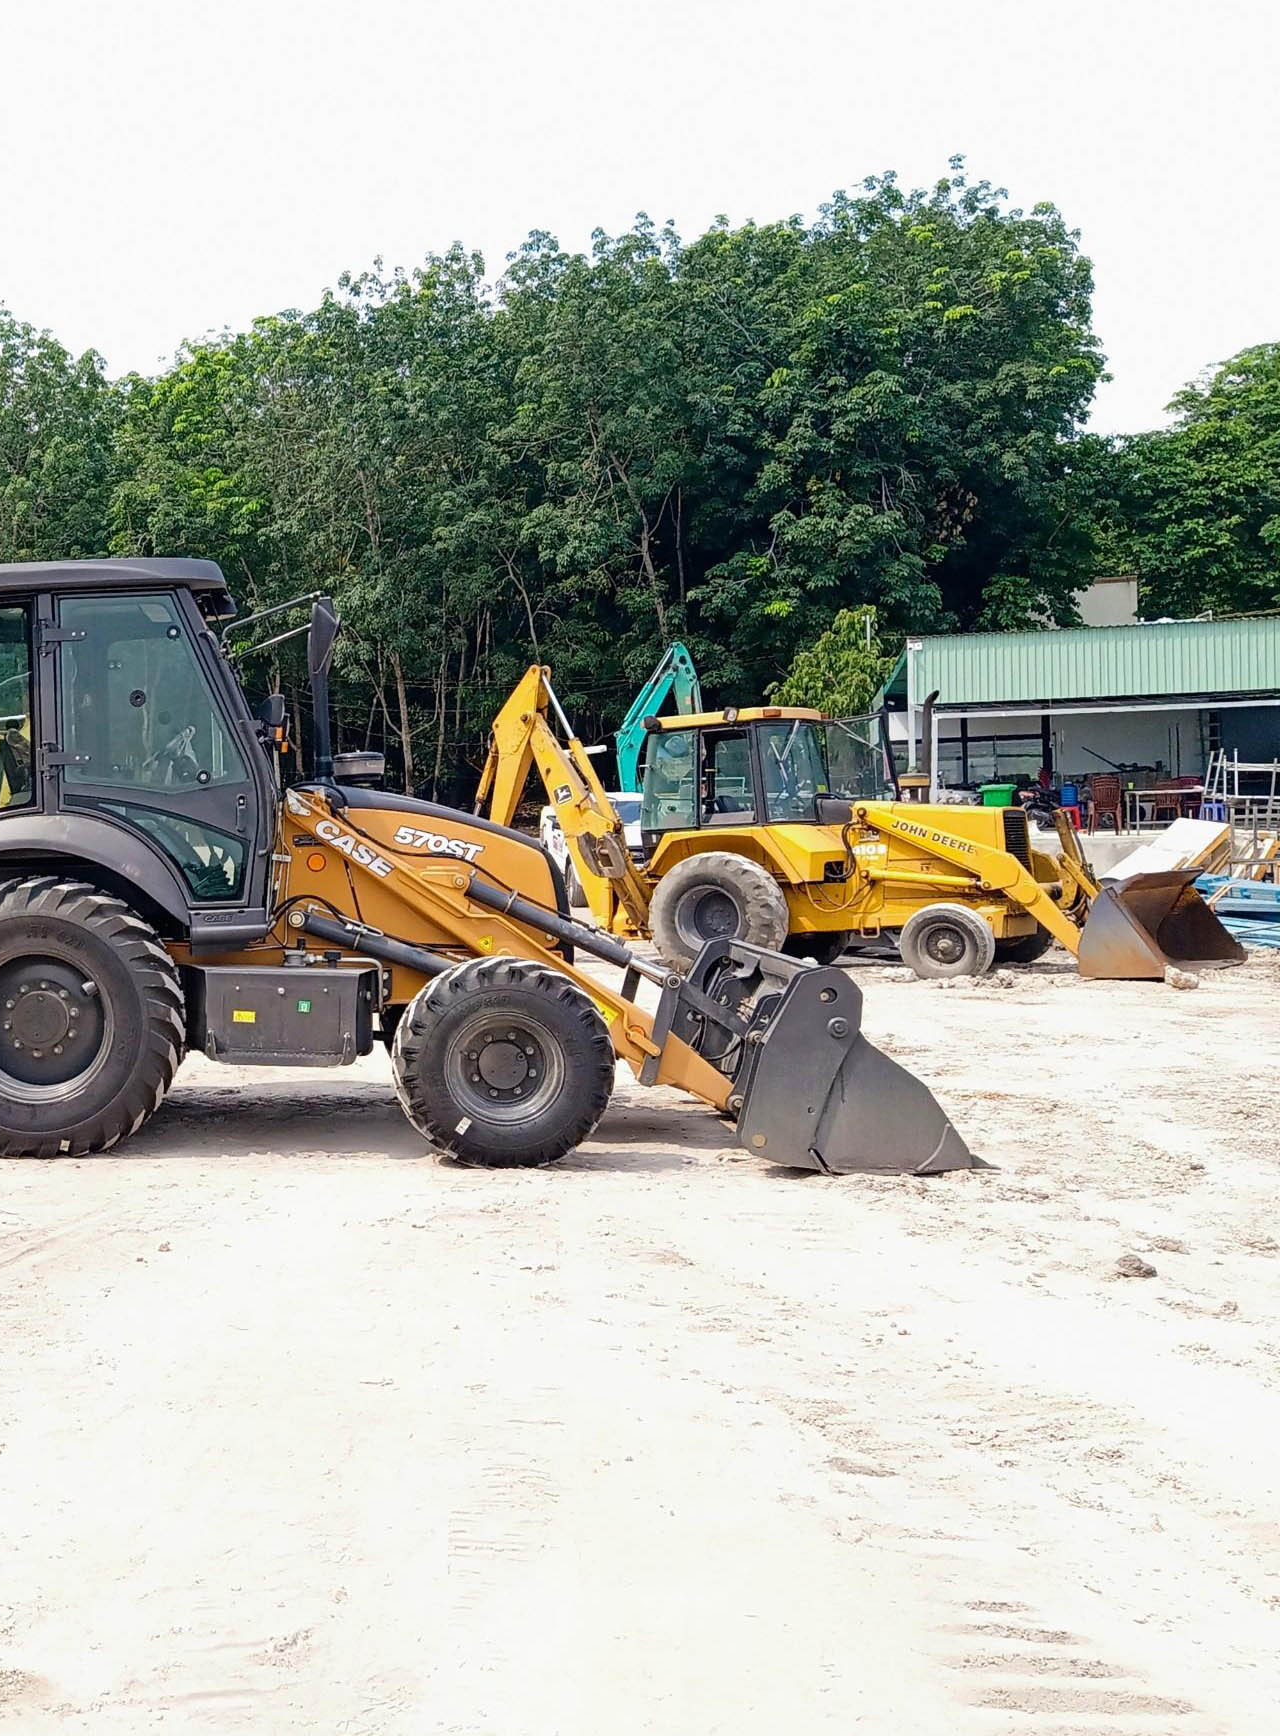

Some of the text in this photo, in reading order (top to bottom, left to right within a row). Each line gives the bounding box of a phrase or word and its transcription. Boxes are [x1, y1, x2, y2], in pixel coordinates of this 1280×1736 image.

[315, 820, 395, 878] CASE
[393, 825, 485, 862] 570ST
[891, 820, 929, 838] JOHN
[931, 833, 977, 854] DEERE
